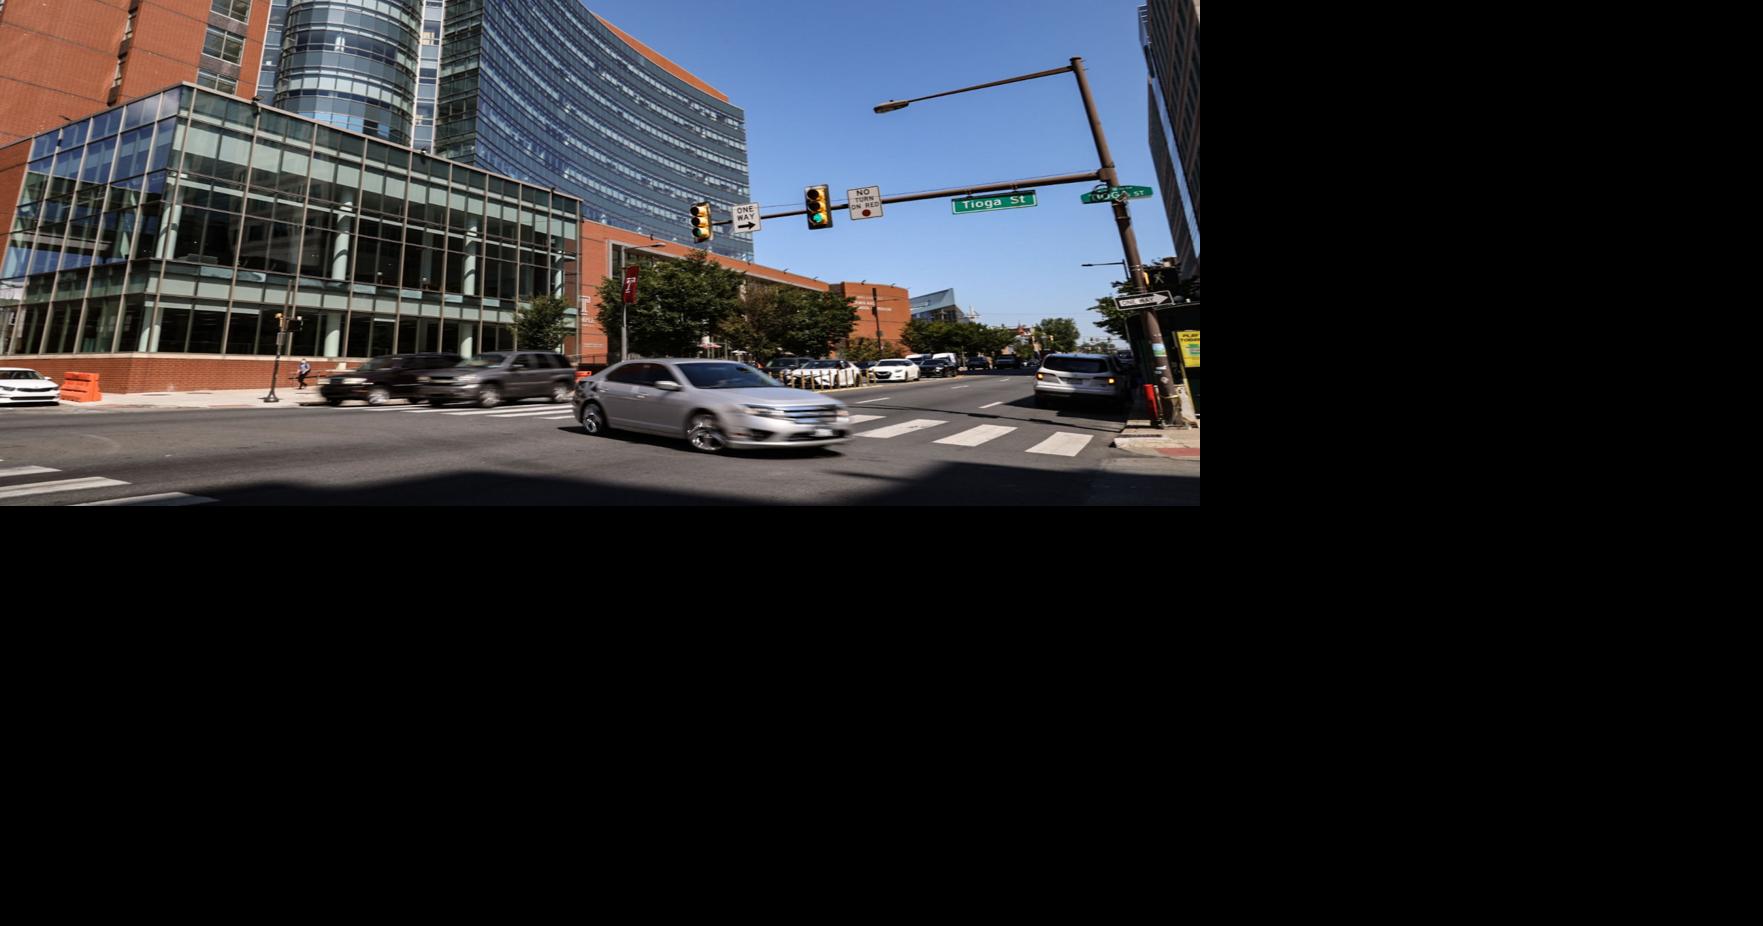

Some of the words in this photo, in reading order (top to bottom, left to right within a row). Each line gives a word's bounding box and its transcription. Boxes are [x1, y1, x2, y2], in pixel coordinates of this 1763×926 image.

[962, 198, 1002, 209] Tioga
[1010, 195, 1026, 204] St
[736, 206, 754, 214] ONE
[737, 212, 755, 221] WAY
